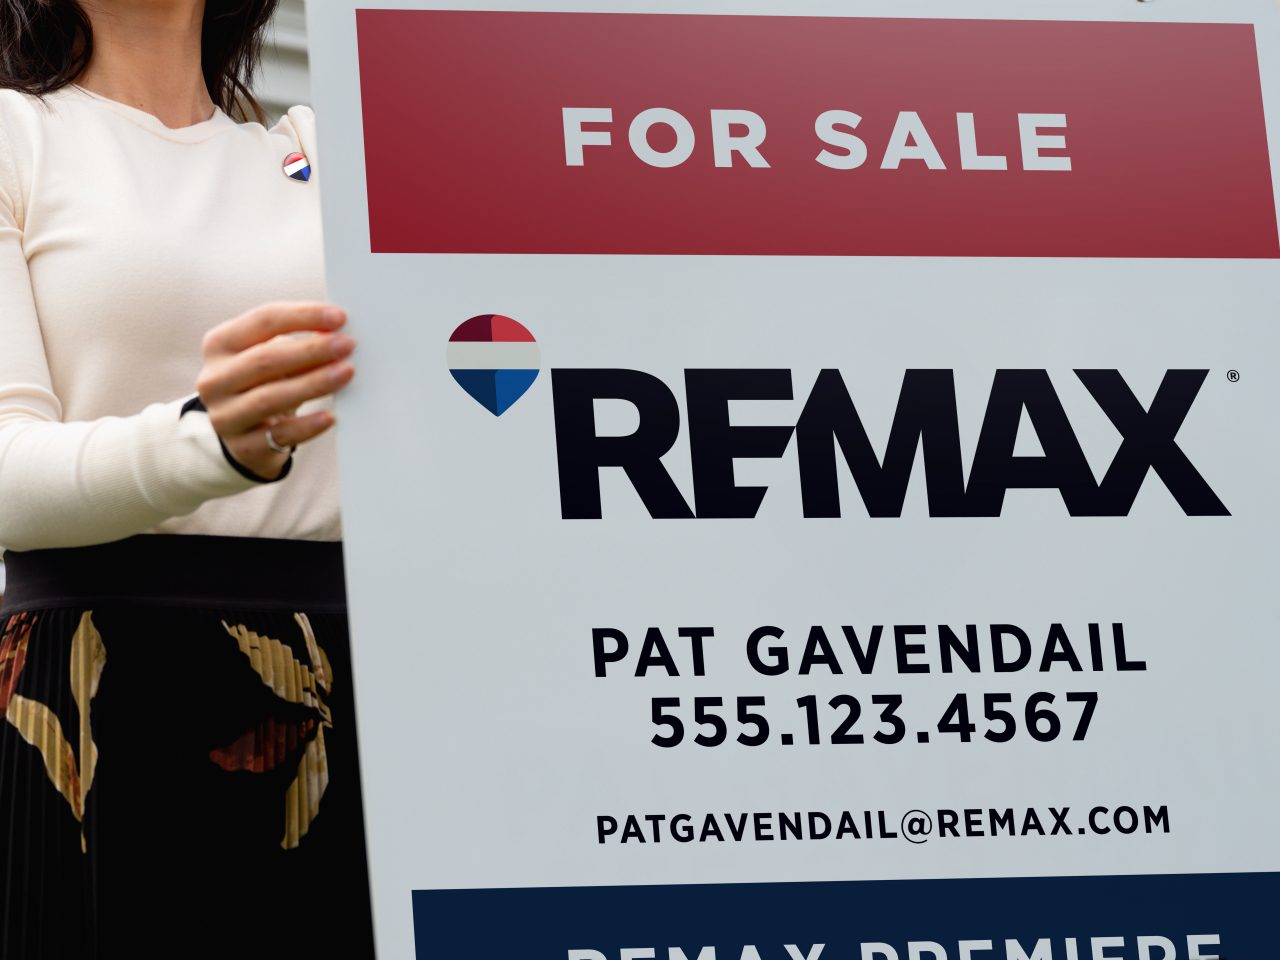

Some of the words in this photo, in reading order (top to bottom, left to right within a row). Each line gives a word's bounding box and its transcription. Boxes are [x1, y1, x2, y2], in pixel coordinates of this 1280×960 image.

[561, 106, 771, 169] FOR
[814, 108, 1073, 172] SALE
[550, 367, 1233, 520] REMAX
[591, 626, 716, 678] PAT
[746, 622, 1147, 677] GAVENDAIL
[650, 691, 1100, 748] 555.123.4567
[596, 805, 1172, 845] PATGAVENDAIL@REMAX.COM
